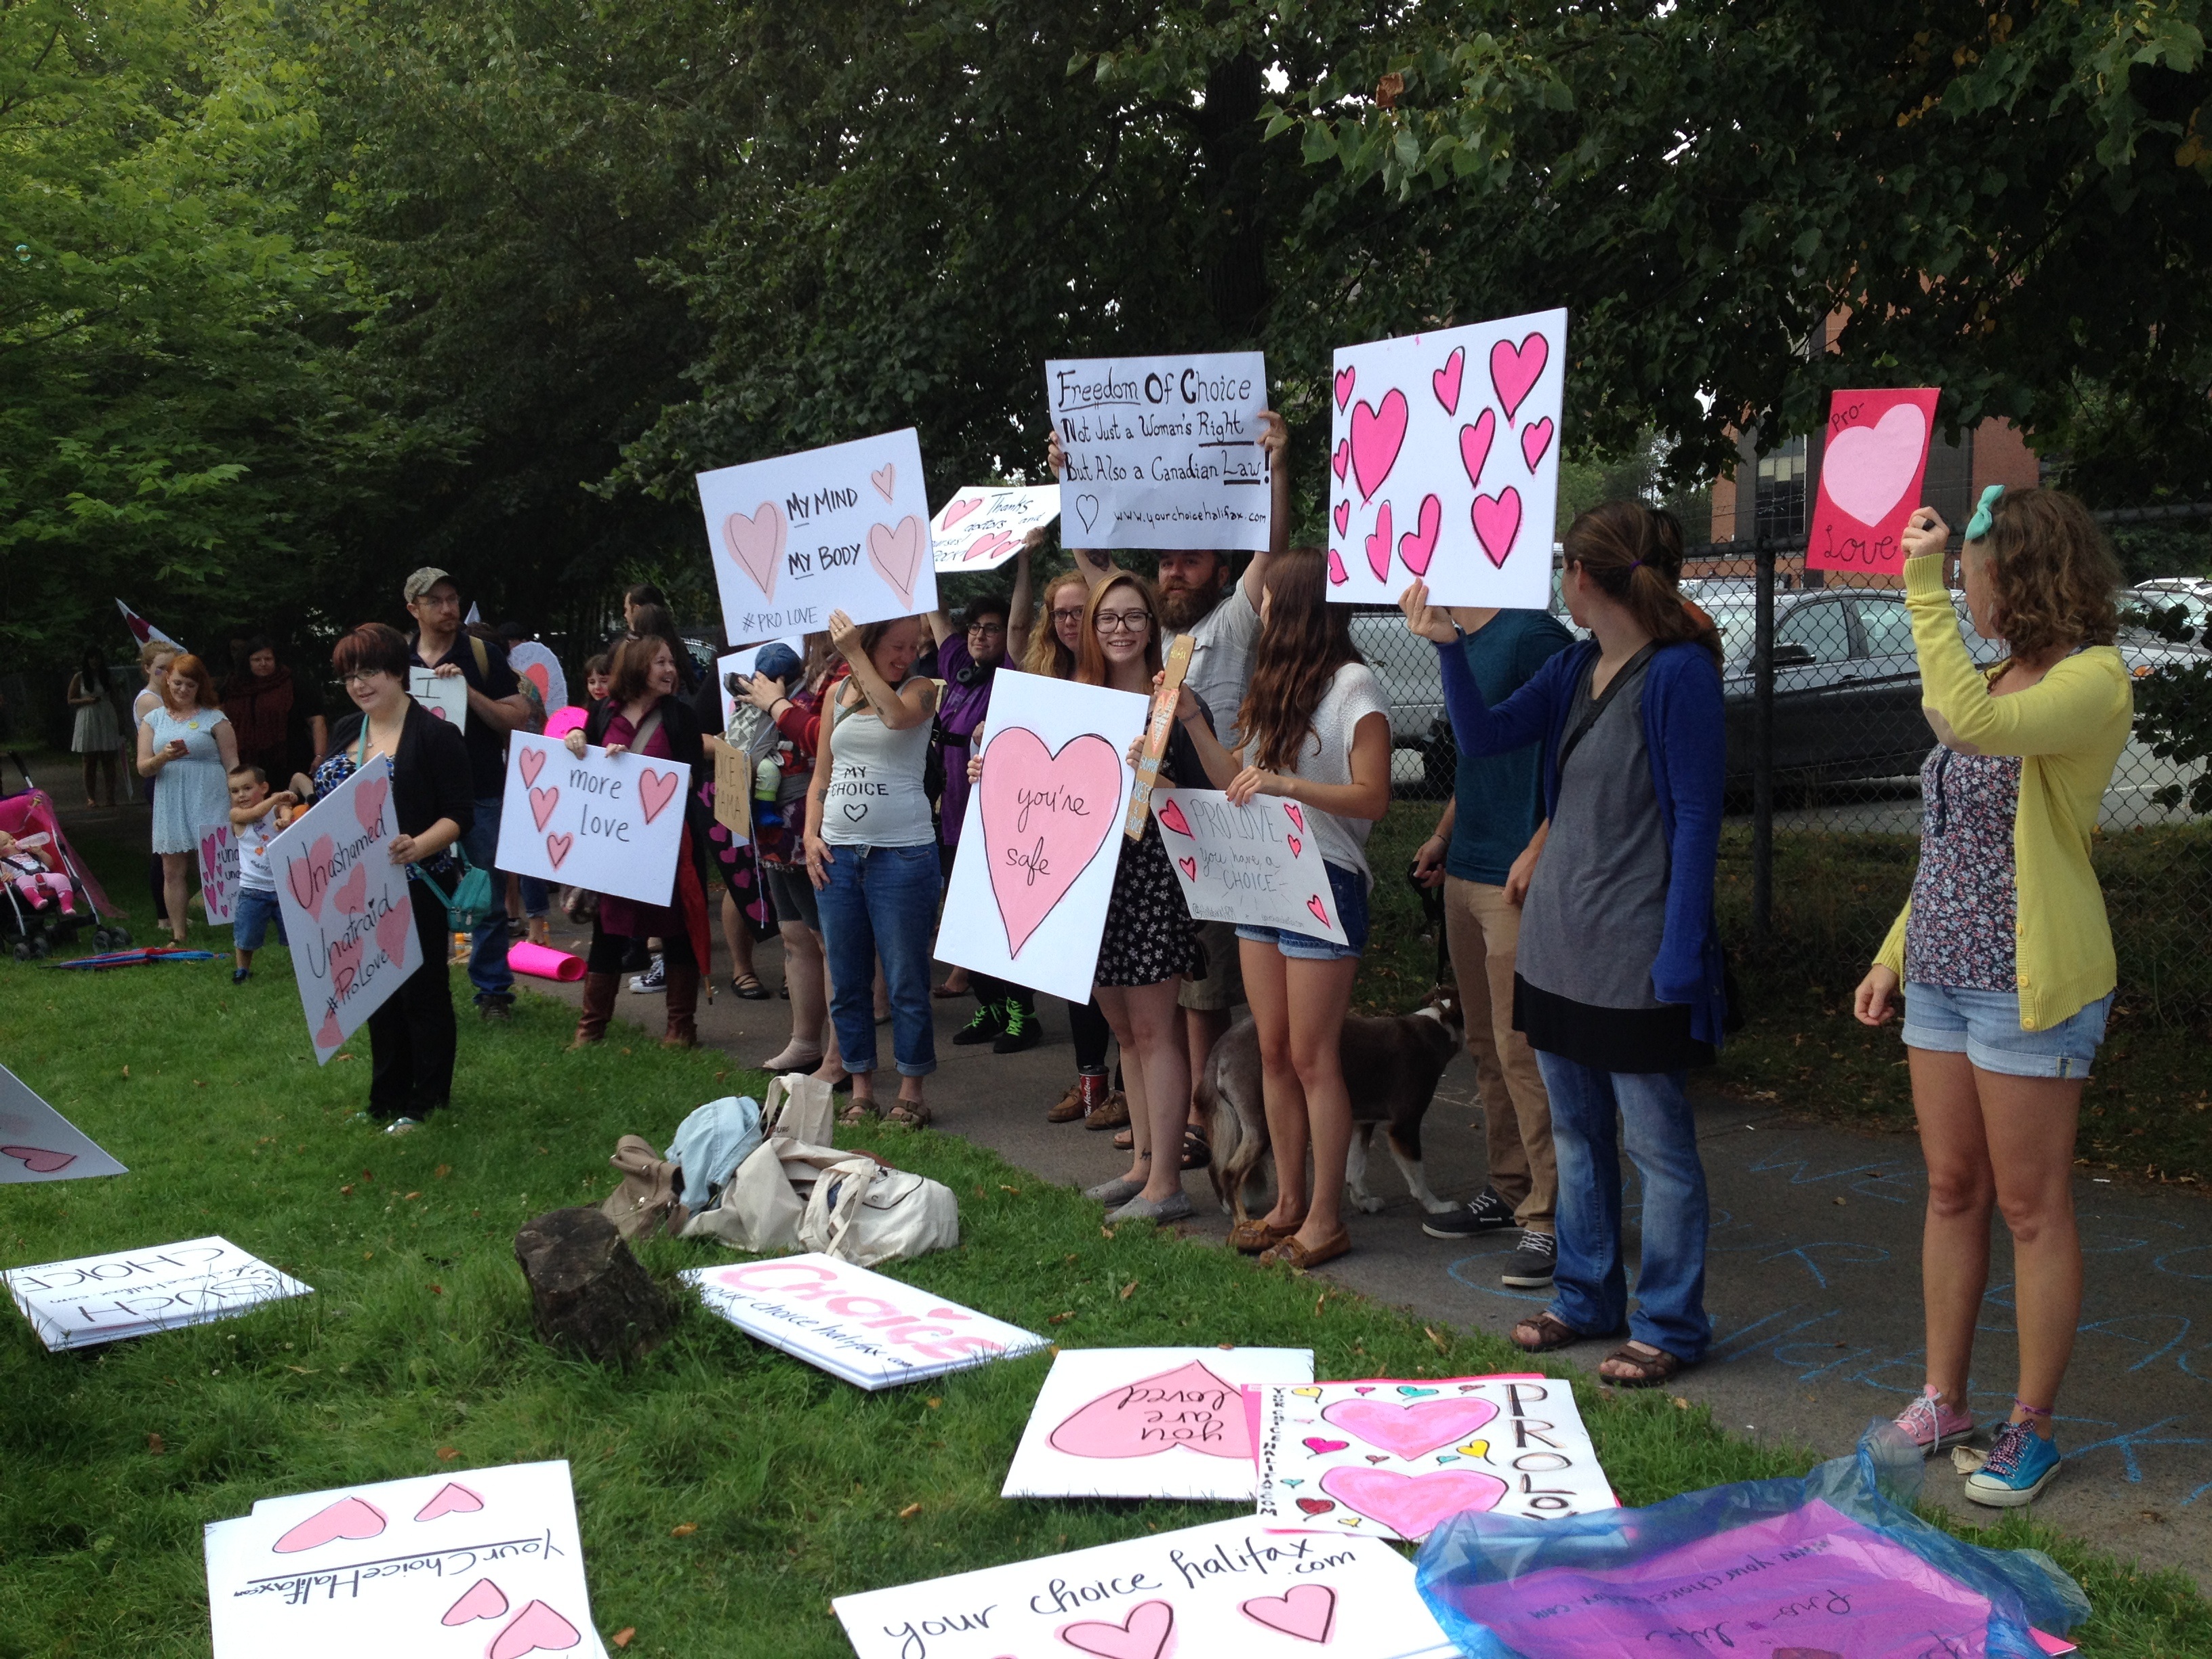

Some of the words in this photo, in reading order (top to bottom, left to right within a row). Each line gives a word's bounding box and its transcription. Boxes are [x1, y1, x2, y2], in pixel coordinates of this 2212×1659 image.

[1057, 367, 1139, 407] Freedom
[1145, 372, 1174, 405] Of
[1180, 368, 1252, 404] Choice
[1061, 415, 1092, 443] Not
[1095, 413, 1122, 441] Just
[1125, 429, 1134, 440] a
[1139, 413, 1192, 437] Woman's
[1197, 409, 1244, 443] Right
[1830, 403, 1865, 432] Pro-
[1063, 451, 1093, 482] But
[1095, 455, 1127, 482] Also
[1133, 466, 1145, 480] a
[1151, 453, 1218, 482] Canadian
[813, 487, 859, 516] MIND
[987, 492, 1034, 516] Thanks
[964, 517, 1008, 533] doctors
[818, 543, 861, 571] BODY
[1824, 524, 1898, 565] Love
[786, 606, 819, 626] LOVE
[570, 769, 622, 799] more
[844, 766, 866, 779] MY
[831, 782, 890, 797] CHOICE
[580, 803, 630, 842] love
[1017, 784, 1090, 834] you're
[286, 804, 387, 910] Unashamed
[1006, 836, 1051, 886] safe
[1199, 846, 1227, 878] you
[1223, 869, 1277, 893] CHOICE
[306, 883, 393, 979] Unafraid
[12, 1247, 225, 1292] CHOICE
[1118, 1385, 1233, 1411] loved
[1141, 1419, 1224, 1441] you
[1143, 1410, 1212, 1424] are
[883, 1604, 998, 1659] your
[1029, 1578, 1162, 1614] choice
[1170, 1536, 1314, 1589] halifax
